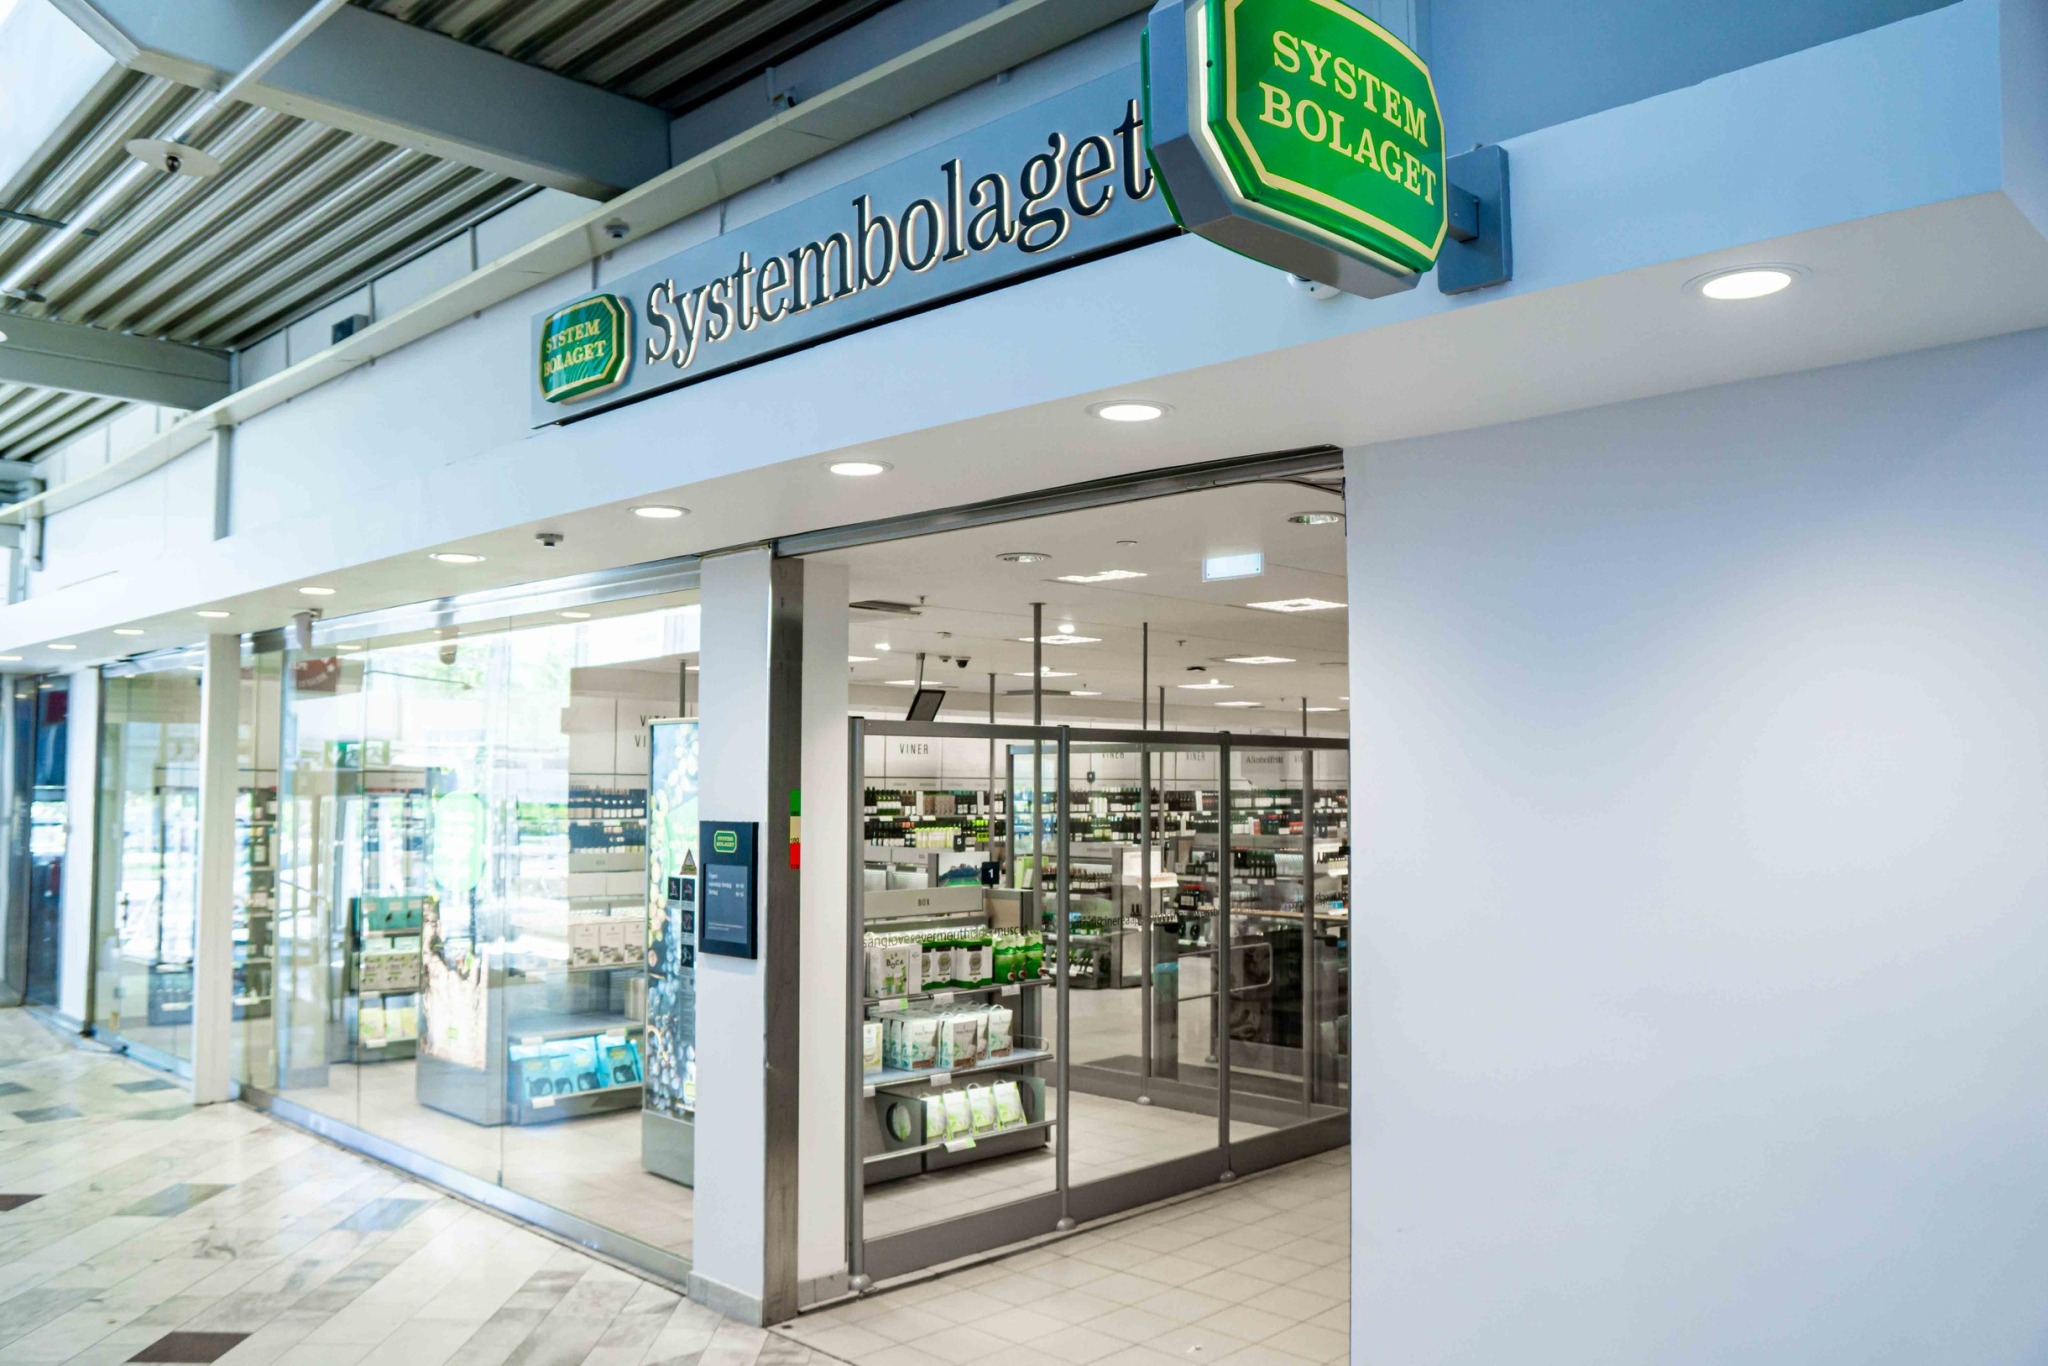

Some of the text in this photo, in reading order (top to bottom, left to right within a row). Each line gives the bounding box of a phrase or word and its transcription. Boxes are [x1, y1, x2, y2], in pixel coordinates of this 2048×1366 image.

[1273, 30, 1428, 148] SYSTEM
[1258, 81, 1437, 206] BOLAGET
[645, 97, 1155, 369] Systembolaget
[545, 318, 601, 354] SYSTEM
[543, 339, 607, 378] BOLAGET
[899, 743, 929, 755] VINER
[988, 868, 994, 879] 1
[917, 898, 930, 907] BOX
[885, 959, 904, 969] BOCA
